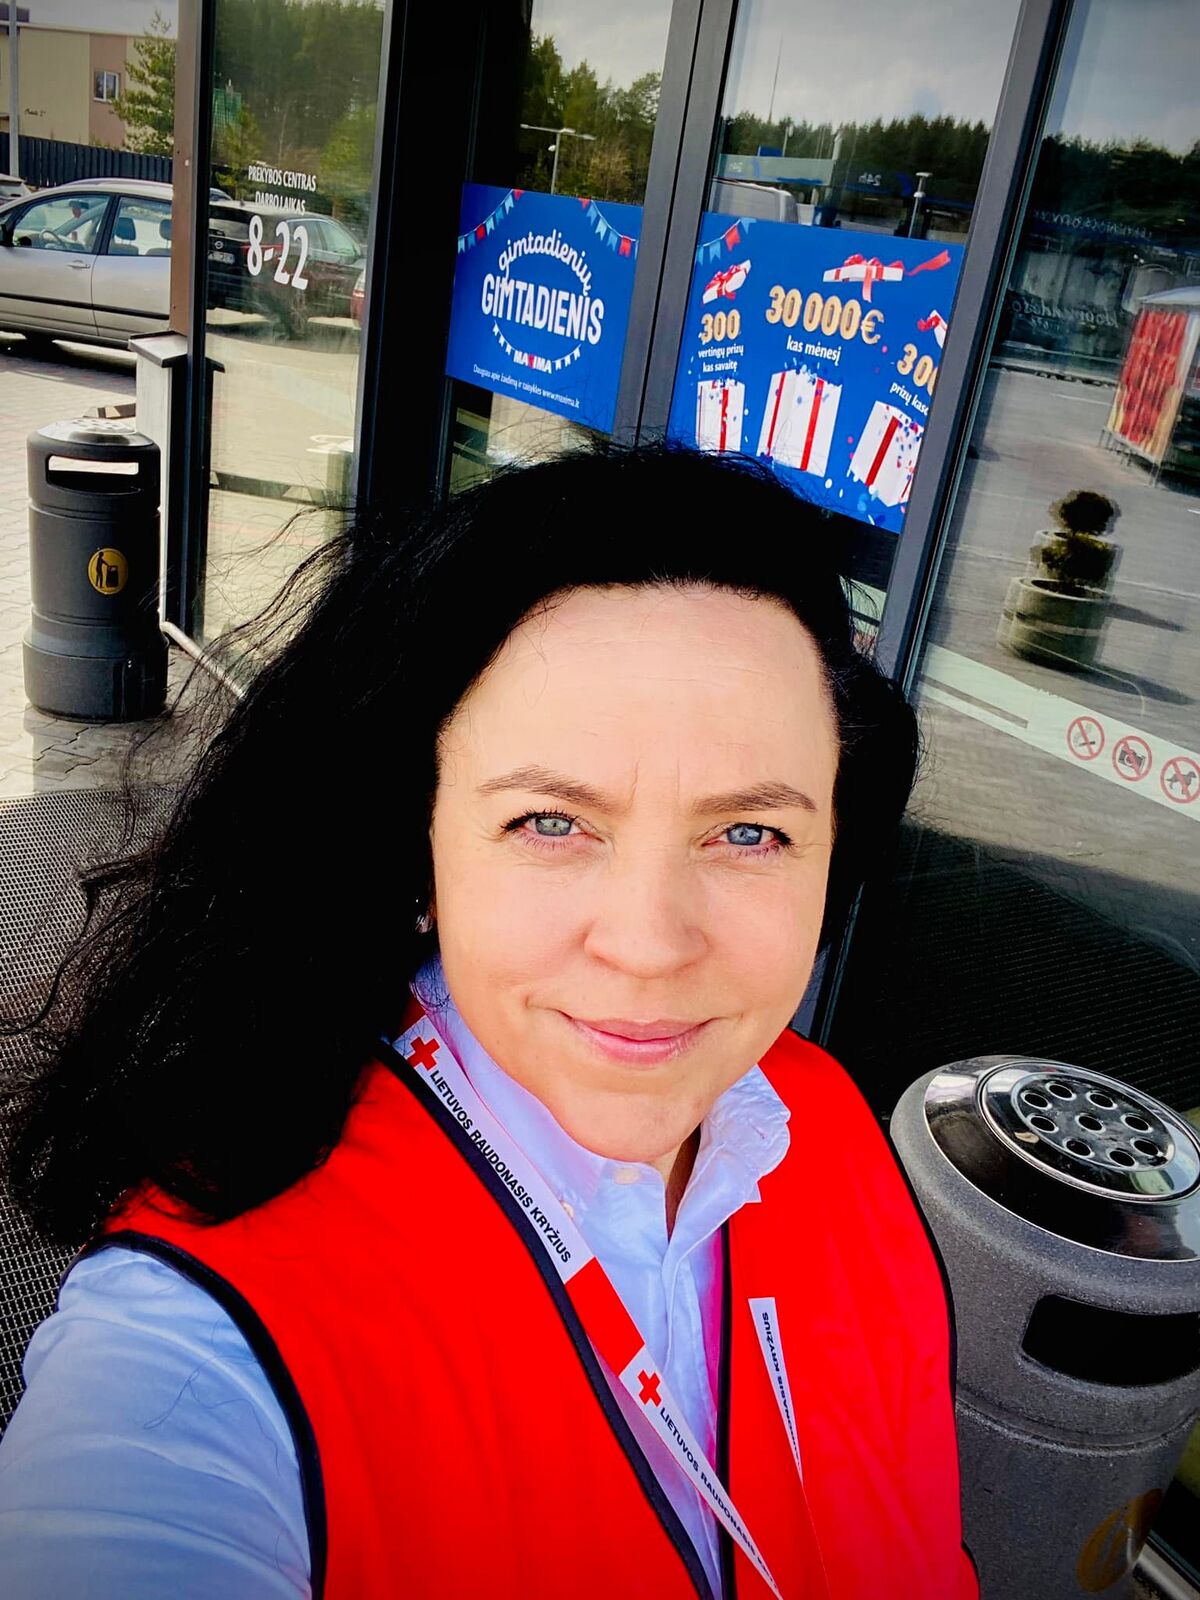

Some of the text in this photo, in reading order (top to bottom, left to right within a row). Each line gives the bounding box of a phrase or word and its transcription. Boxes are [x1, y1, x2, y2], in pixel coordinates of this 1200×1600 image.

[248, 165, 317, 192] PREKYBOS CENTRAS
[247, 215, 309, 290] 8-22
[498, 228, 593, 296] gimtadienių
[481, 273, 604, 345] GIMTADIENIS
[700, 309, 741, 344] 300
[513, 350, 553, 374] MAXIMA
[698, 343, 744, 359] vertingų prizų
[702, 359, 738, 373] kas savaitę
[786, 335, 842, 366] kas mėnesį
[889, 382, 912, 406] prizų
[429, 1070, 571, 1263] LIETUVOS RAUDONASIS KRYŽIUS
[659, 1407, 699, 1472] LIETUVOS
